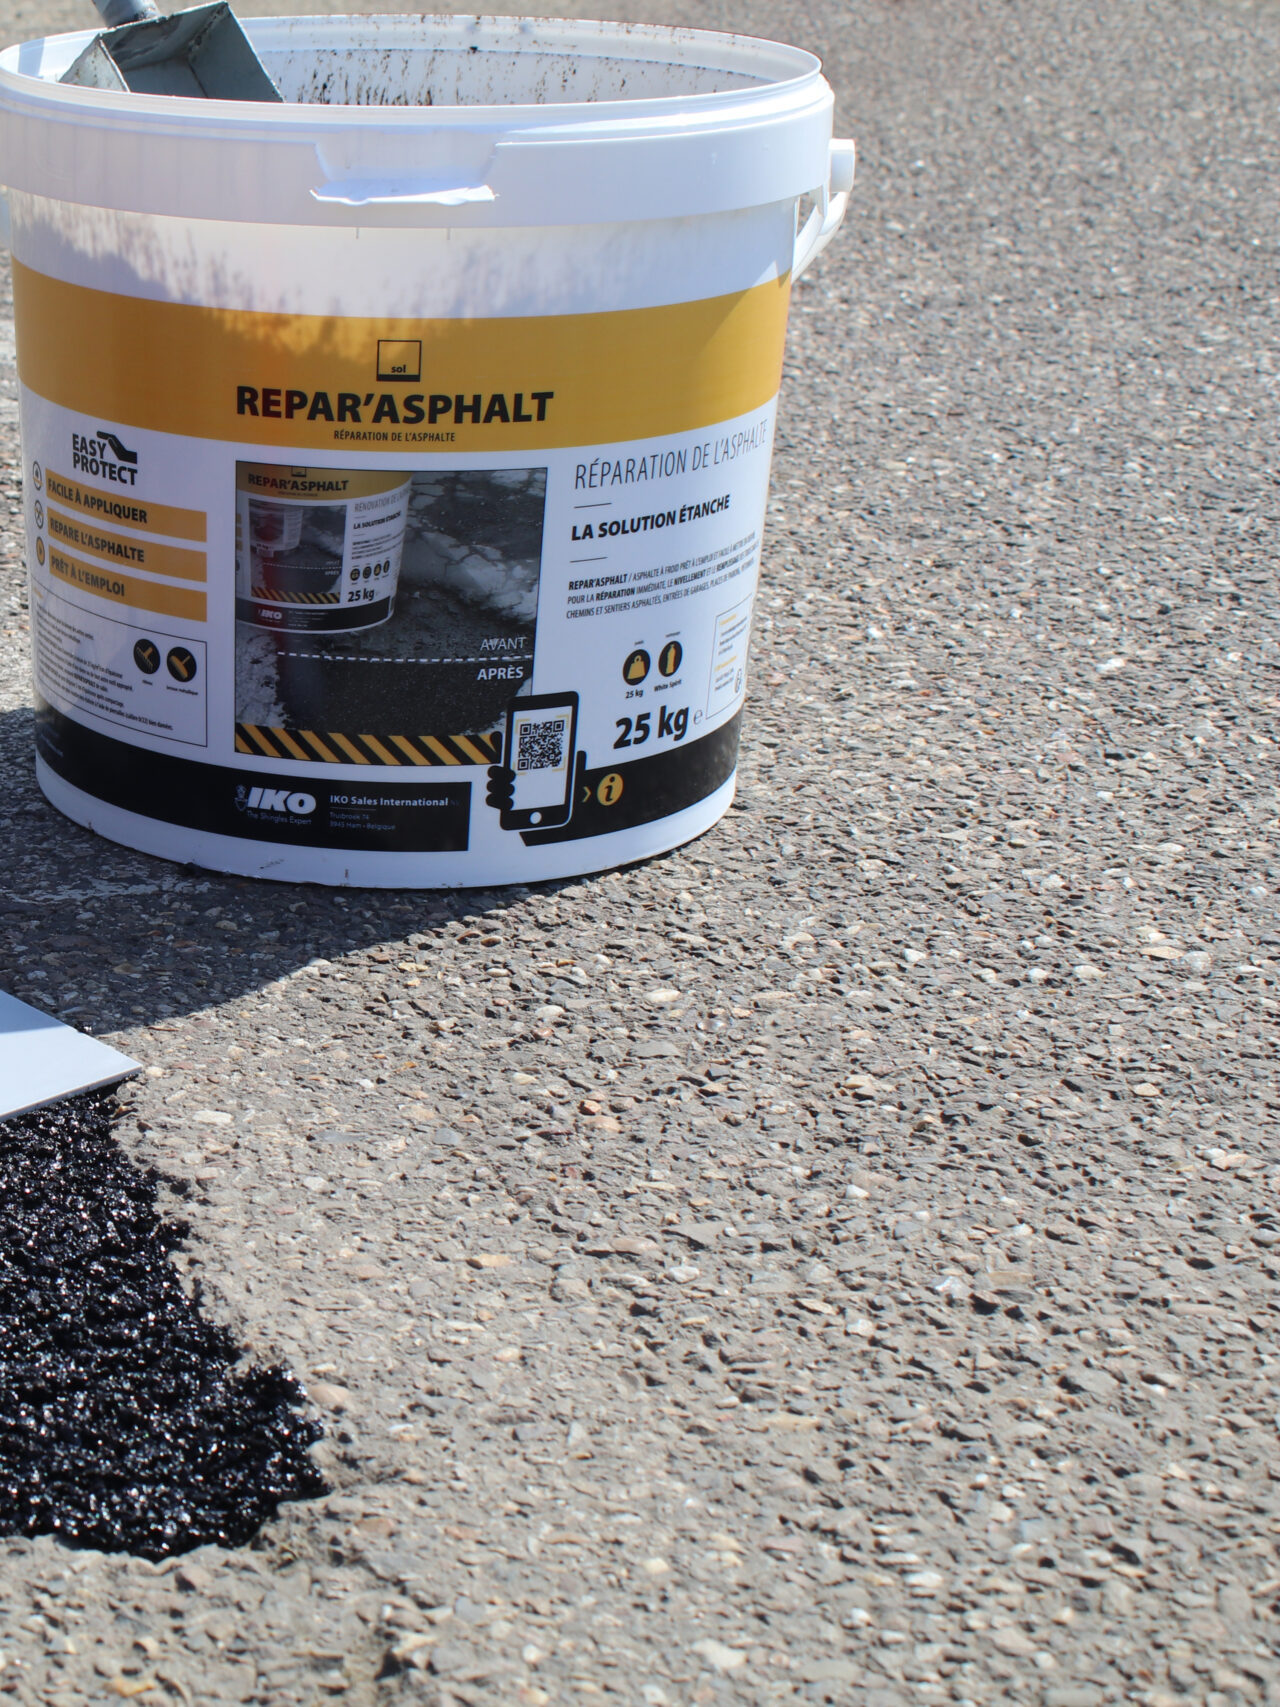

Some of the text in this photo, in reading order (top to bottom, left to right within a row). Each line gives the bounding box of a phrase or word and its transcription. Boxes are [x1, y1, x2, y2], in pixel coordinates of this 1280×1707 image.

[390, 364, 407, 374] sol
[236, 385, 554, 424] REPAR'ASPHALT
[72, 433, 107, 460] EASY
[334, 429, 456, 442] RÉPARATION DE L'ASPHALTE
[574, 418, 769, 490] RÉPARATION DE L'ASPHALTE
[72, 452, 138, 485] PROTECT
[248, 473, 349, 491] REPAR'ASPHALT
[48, 477, 148, 524] FACILE À APPLIQUER
[571, 494, 731, 541] LA SOLUTION ÉTANCHE
[50, 517, 145, 563] REPARE L'ASPHALTE
[51, 555, 126, 597] PRÊT À L'EMPLOI
[568, 573, 628, 590] REPAR'ASPHALT
[632, 568, 660, 582] ASPHALTE
[347, 588, 375, 602] 25 kg
[567, 594, 585, 604] POUR
[586, 593, 595, 603] LA
[596, 586, 636, 601] RÉPARATION
[566, 606, 594, 619] CHEMINS
[596, 606, 604, 616] ET
[604, 602, 632, 614] SENTIERS
[480, 636, 527, 651] AVANT
[477, 664, 524, 681] APRÈS
[625, 689, 643, 699] 25 kg
[613, 712, 651, 749] 25
[658, 705, 690, 742] kg
[247, 786, 317, 815] IKO
[330, 795, 348, 805] IKO
[350, 796, 378, 806] Sales
[380, 797, 448, 807] International
